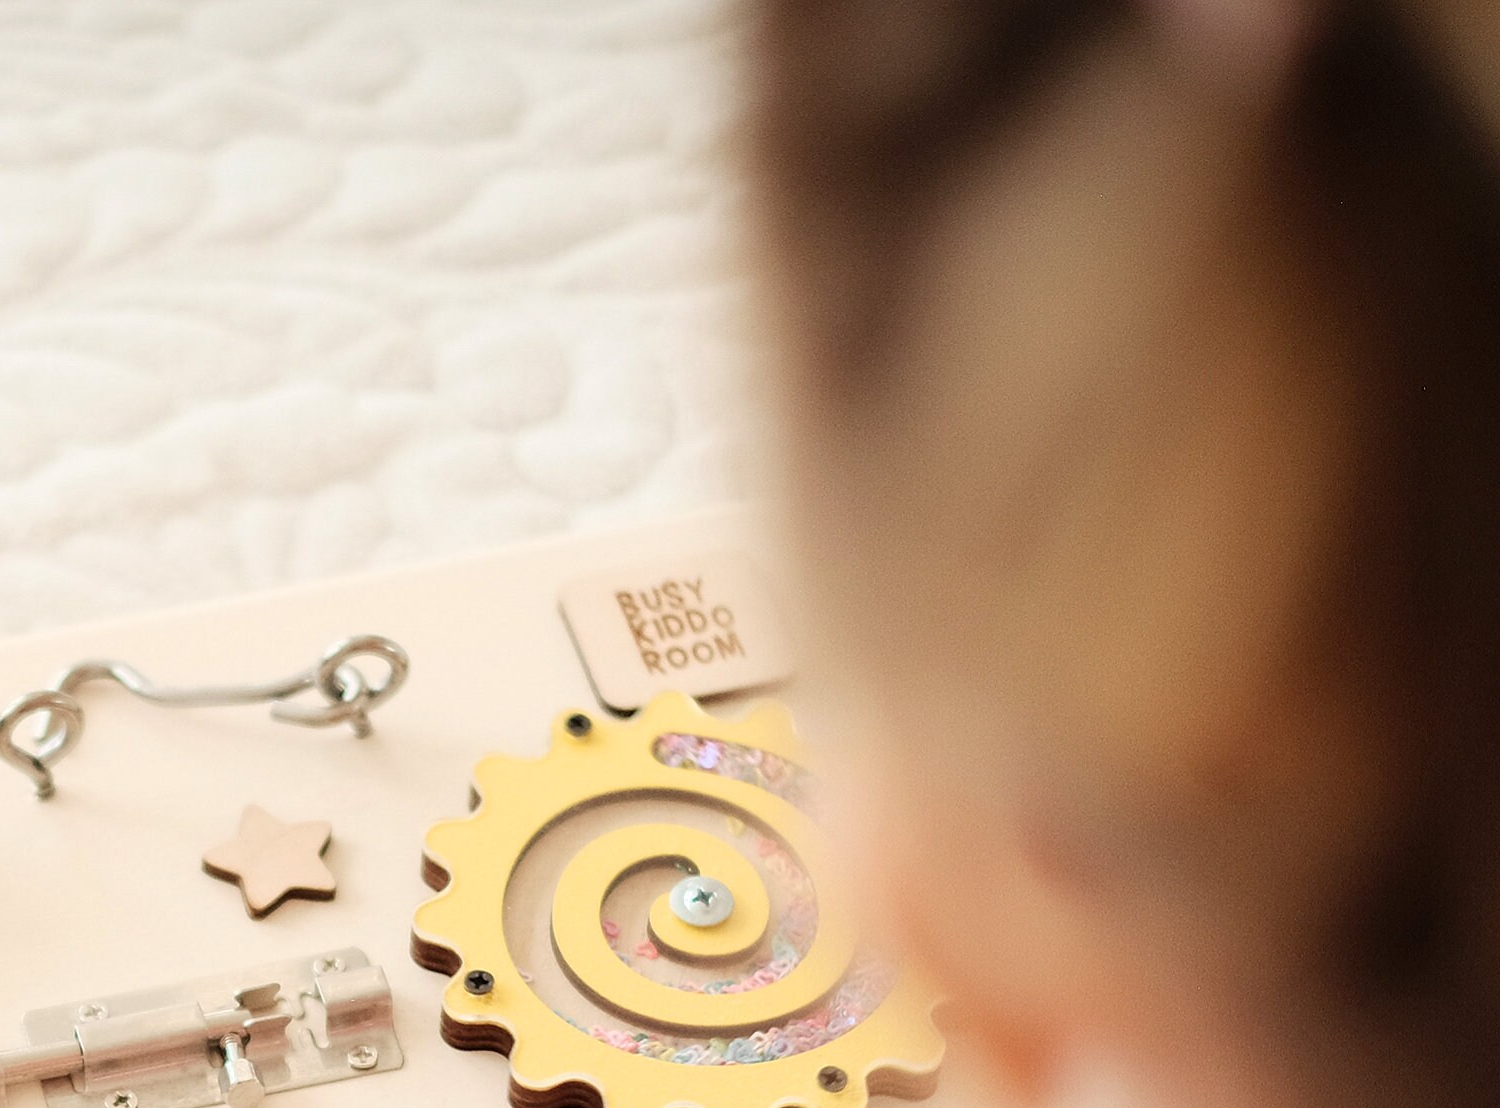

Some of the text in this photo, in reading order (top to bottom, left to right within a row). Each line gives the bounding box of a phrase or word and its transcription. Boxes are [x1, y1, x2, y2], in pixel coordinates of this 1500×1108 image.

[616, 578, 703, 619] BUSY
[630, 606, 733, 649] KIDDO
[641, 633, 746, 675] ROOM
